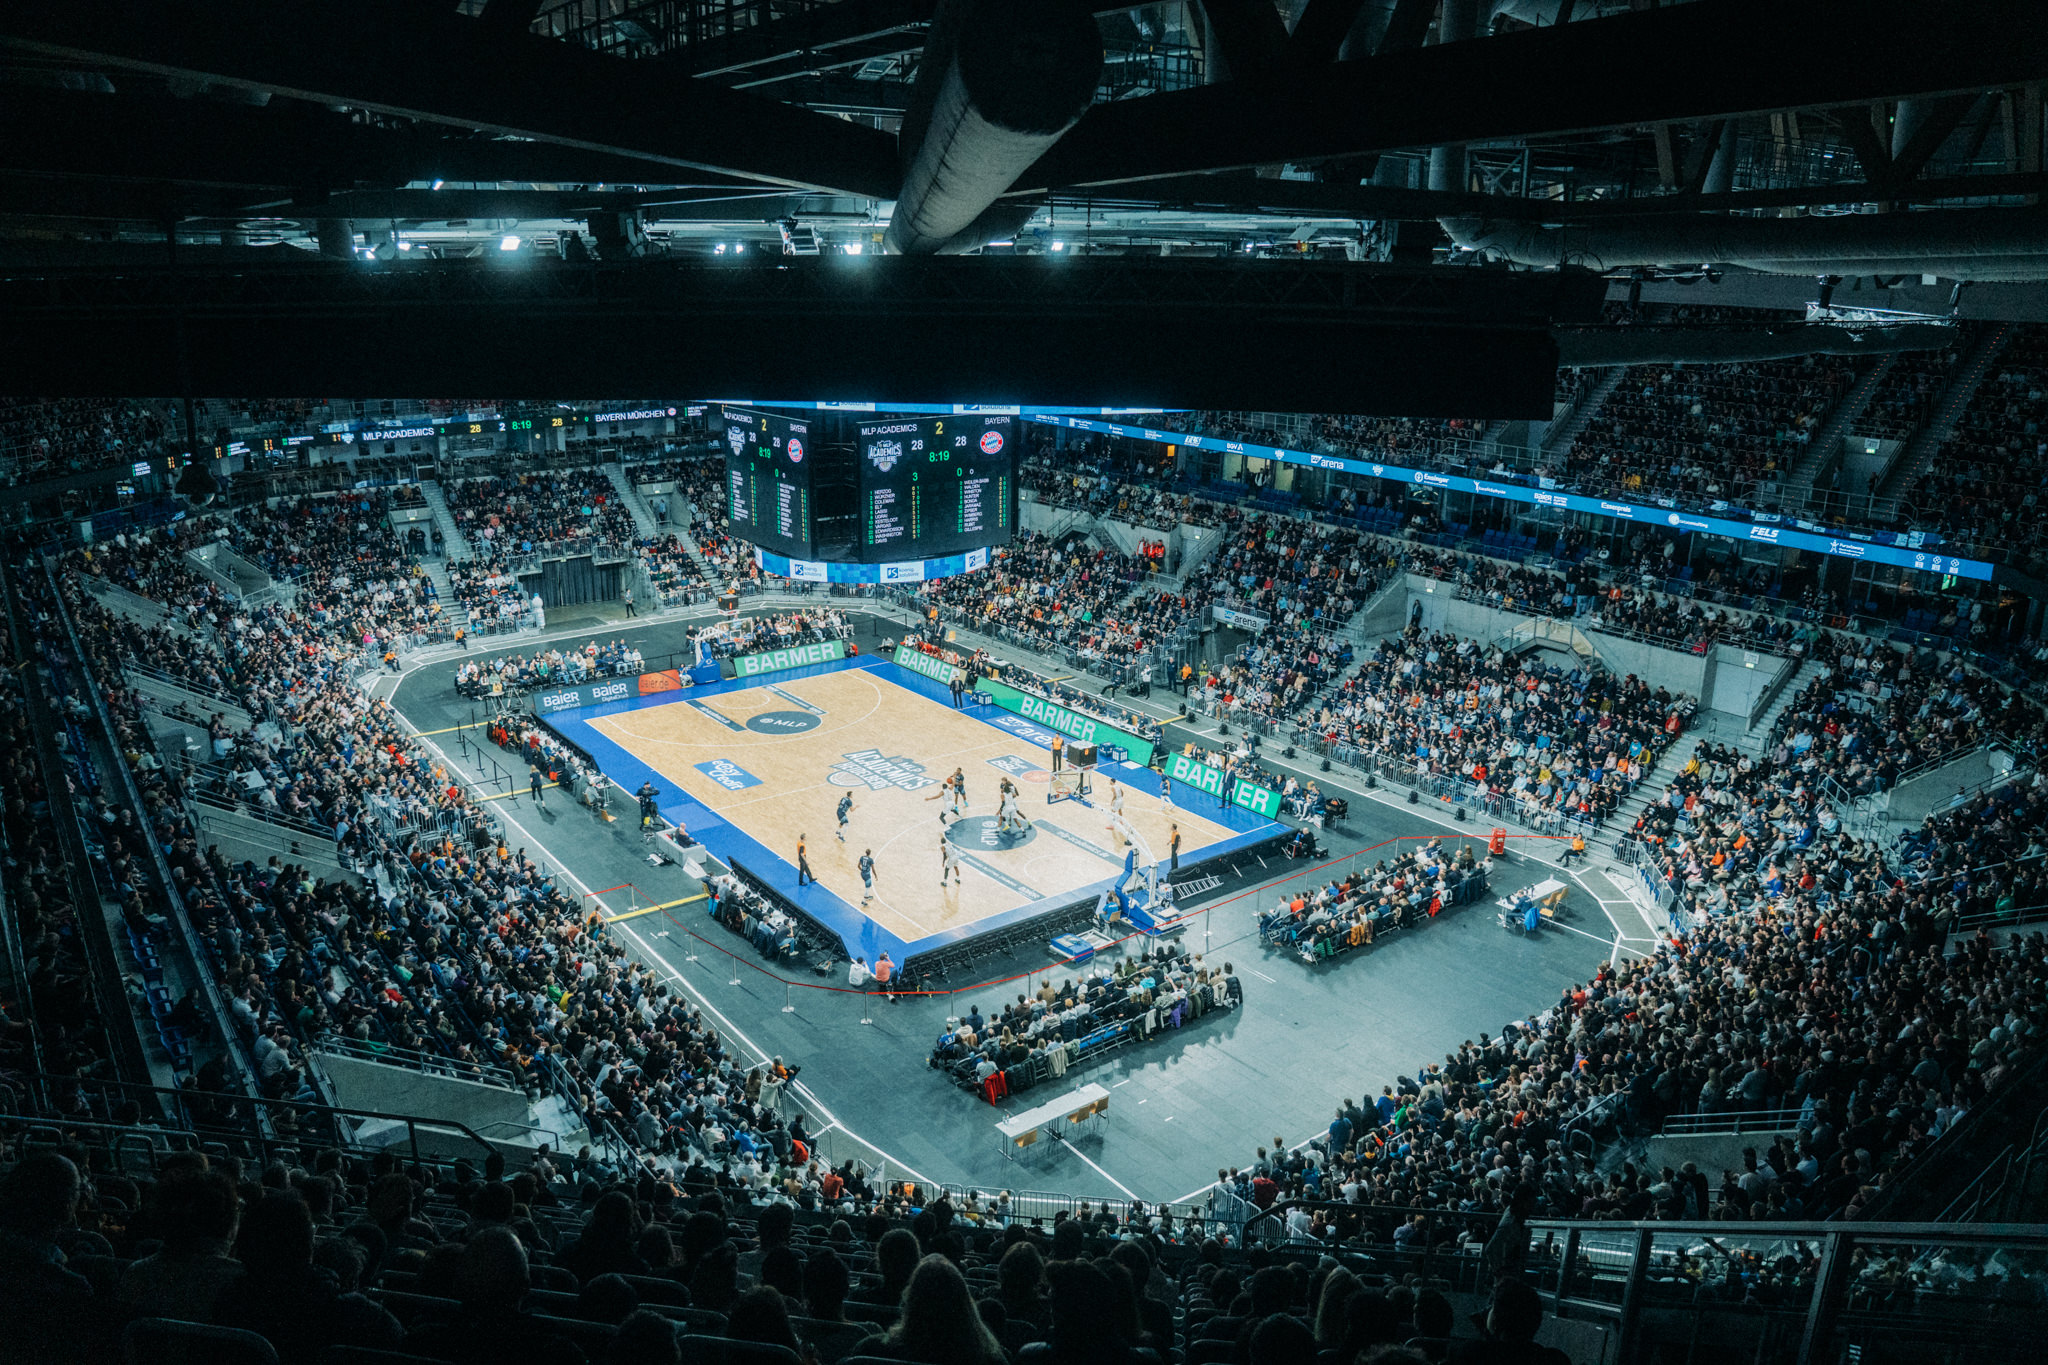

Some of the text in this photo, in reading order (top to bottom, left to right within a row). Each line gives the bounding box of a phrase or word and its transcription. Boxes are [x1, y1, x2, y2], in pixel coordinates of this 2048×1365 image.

[552, 417, 563, 427] 28
[595, 410, 665, 423] BAYERN MÜNCHEN
[985, 416, 1010, 425] BAYERN
[469, 424, 481, 433] 28
[499, 422, 506, 432] 2
[512, 420, 532, 430] 8:19
[762, 418, 767, 431] 2
[861, 423, 918, 436] MLP ACADEMICS
[935, 421, 944, 435] 2
[362, 427, 435, 441] MLP ACADEMICS
[749, 431, 756, 442] 28
[773, 436, 780, 448] 28
[911, 440, 924, 451] 28
[955, 436, 967, 447] 28
[759, 446, 771, 459] 8:19
[929, 450, 950, 462] 8:19
[750, 462, 755, 471] 3
[1321, 458, 1344, 469] arena
[775, 468, 779, 477] 0
[912, 472, 918, 481] 3
[956, 467, 963, 477] 0
[1750, 526, 1779, 538] FELS
[1234, 615, 1257, 628] arena
[744, 642, 836, 674] BARMER
[899, 648, 960, 682] BARMER
[772, 719, 808, 728] MLP
[1020, 695, 1096, 742] BARMER
[844, 750, 937, 790] ACADEMICS
[897, 761, 923, 773] MLP
[980, 828, 999, 847] MLP
